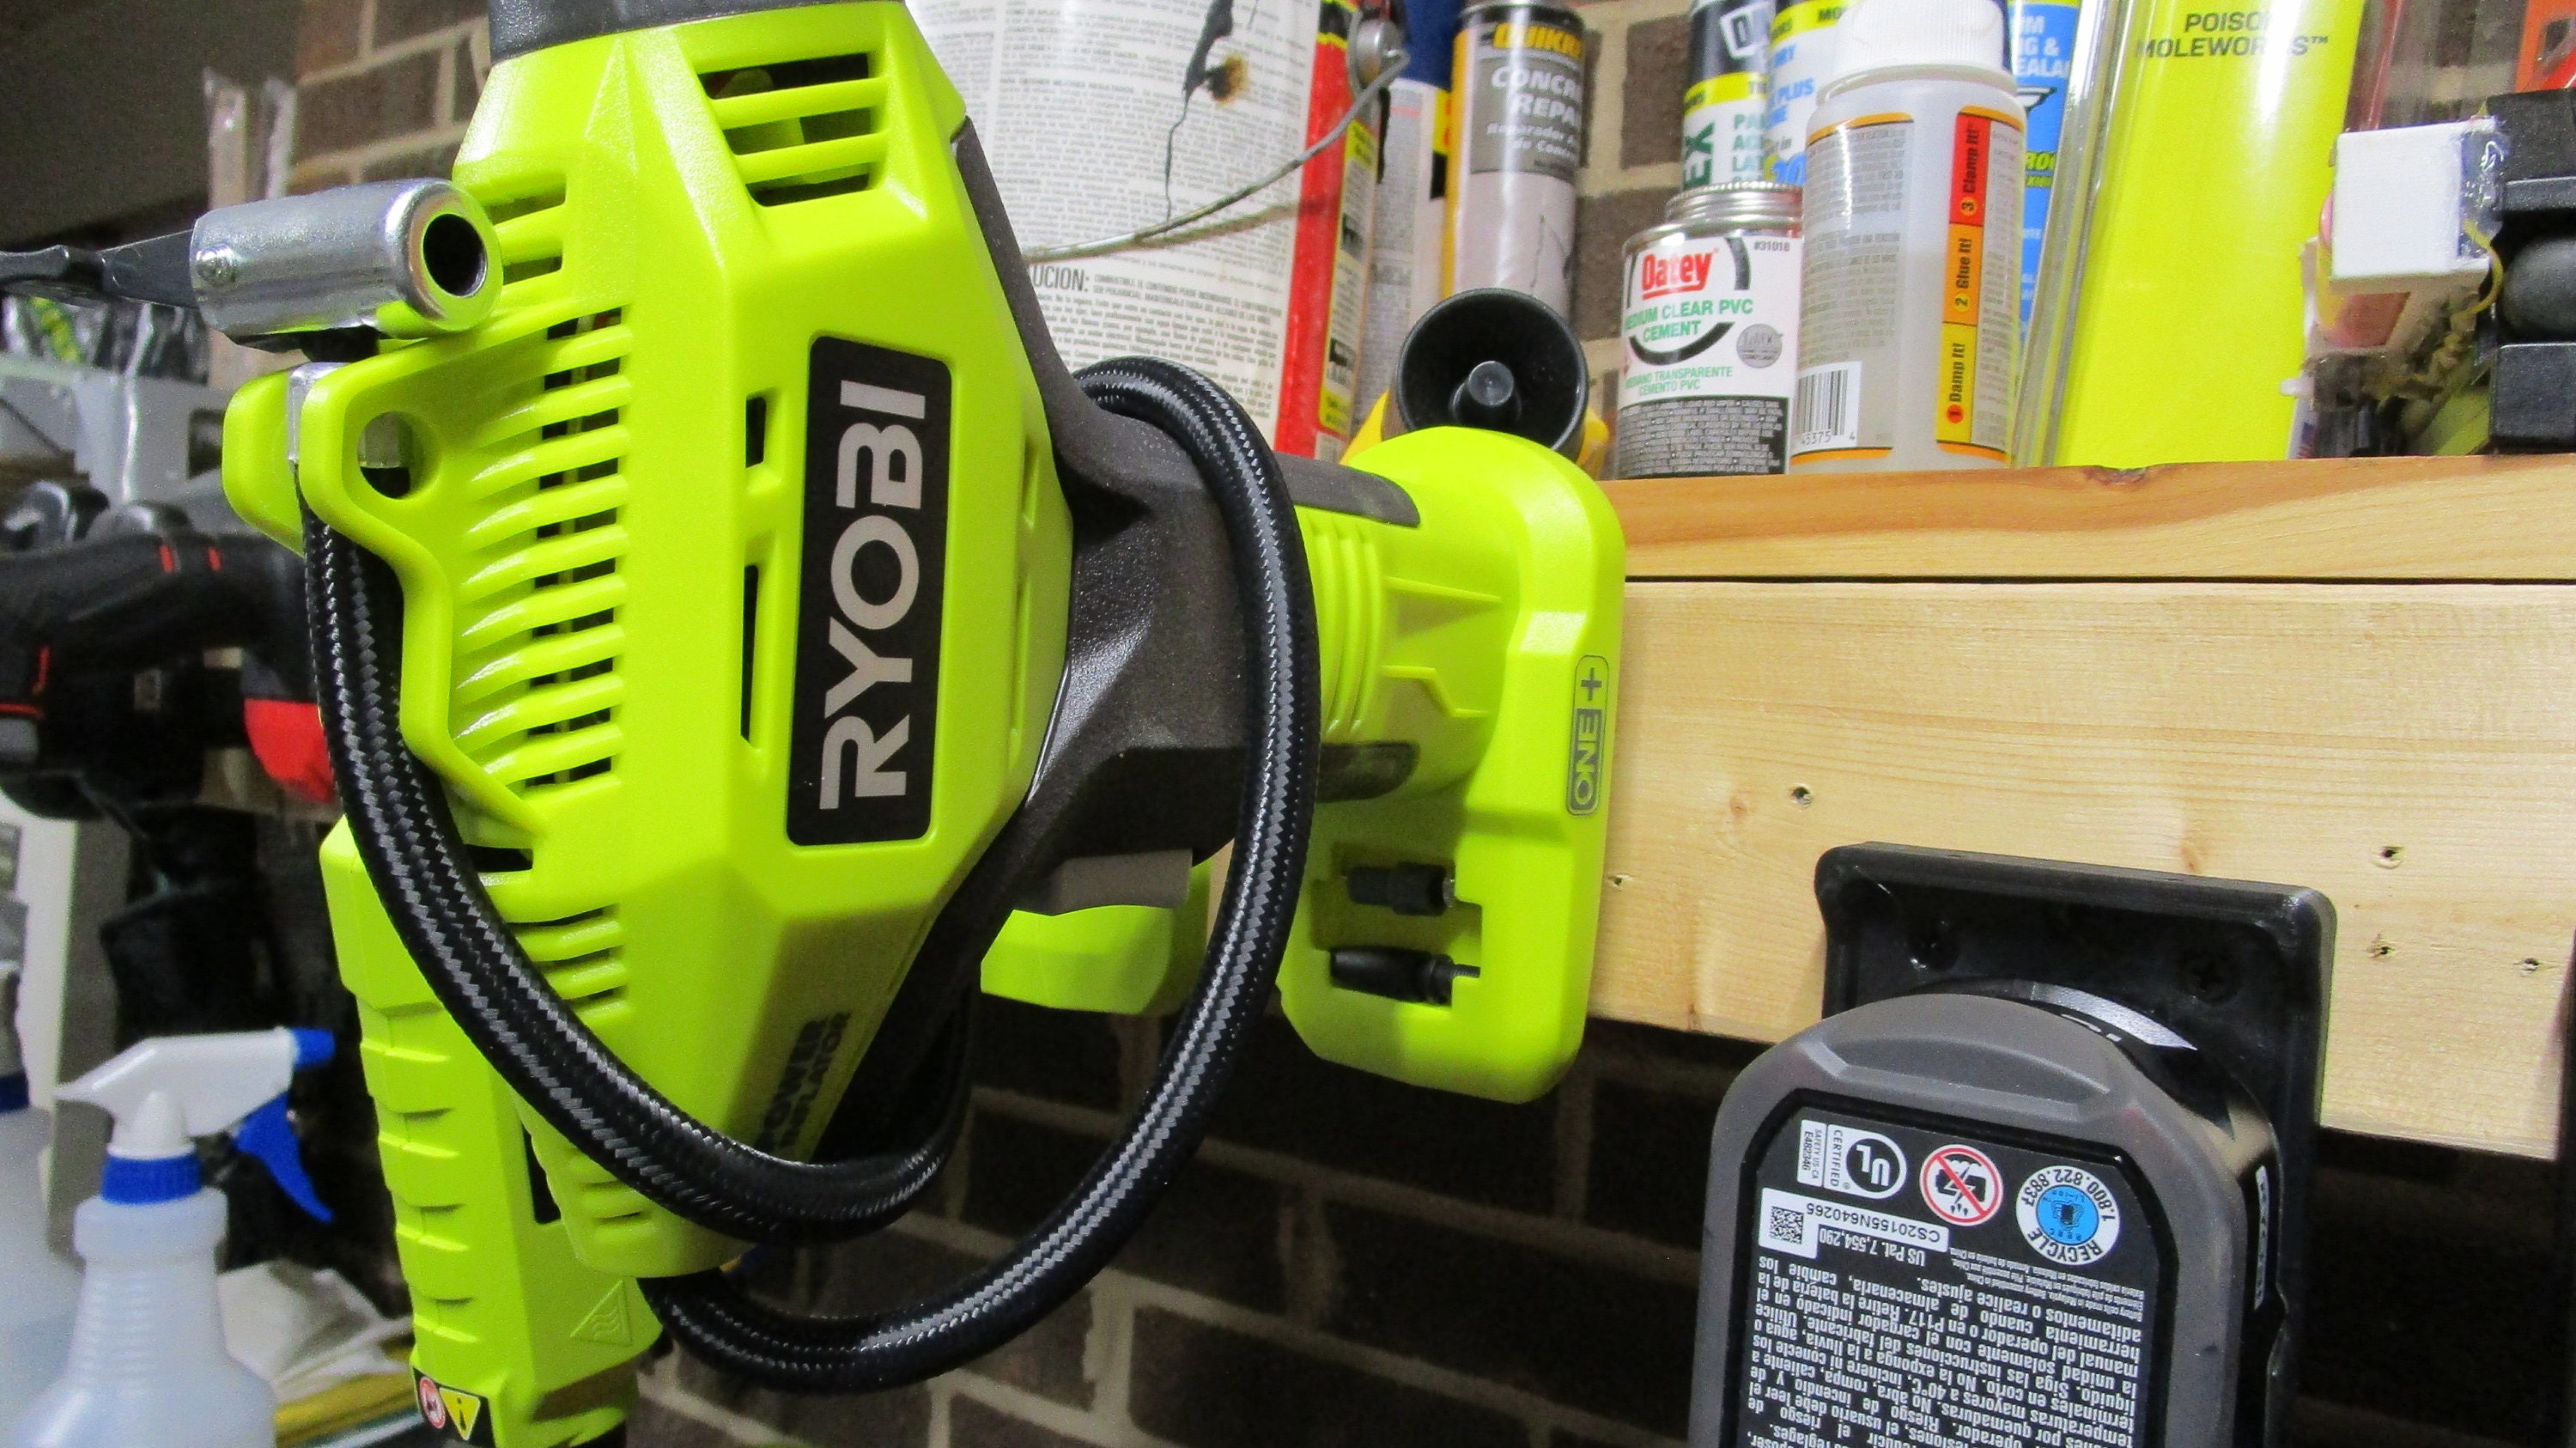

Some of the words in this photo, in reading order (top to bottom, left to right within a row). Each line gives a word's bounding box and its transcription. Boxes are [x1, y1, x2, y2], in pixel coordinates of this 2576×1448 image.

[1030, 265, 1090, 293] UCION:
[1642, 244, 1713, 298] Oatey
[1955, 257, 1972, 290] Glue
[1662, 301, 1713, 319] CLEAR
[1720, 299, 1753, 315] PVC
[1643, 320, 1701, 343] CEMENT
[1949, 362, 1966, 404] Damp
[818, 379, 927, 810] RYOBI
[1574, 703, 1598, 804] ONE
[1830, 1129, 1844, 1188] CERTIFIED
[1856, 1144, 1891, 1187] UL
[1819, 1227, 1878, 1256] 7,554,290
[1880, 1239, 1906, 1262] Pat.
[2026, 1227, 2103, 1262] RECYCLE
[1758, 1255, 1778, 1274] los
[1909, 1250, 1926, 1267] US
[1758, 1271, 1770, 1288] la
[1773, 1275, 1789, 1293] de
[1788, 1262, 1837, 1288] cambie
[1756, 1287, 1769, 1305] el
[1774, 1292, 1790, 1307] en
[1792, 1280, 1838, 1305] batería
[1841, 1292, 1855, 1310] la
[1847, 1274, 1940, 1314] almacenarla,
[1916, 1273, 1973, 1305] ajustes.
[1755, 1303, 1797, 1328] Utilice
[1795, 1297, 1852, 1325] indicado
[1857, 1296, 1899, 1321] Retire
[1949, 1301, 1968, 1321] de
[1976, 1291, 2028, 1317] realice
[2032, 1304, 2041, 1318] o
[1753, 1318, 1761, 1331] o
[1765, 1318, 1797, 1341] agua
[1801, 1315, 1874, 1348] fabricante.
[1857, 1310, 1920, 1343] cargador
[1904, 1307, 1944, 1332] P117.
[1947, 1318, 1965, 1335] en
[1969, 1323, 1978, 1338] o
[1979, 1309, 2033, 1337] cuando
[2044, 1307, 2141, 1345] aditamentos
[1752, 1334, 1771, 1353] los
[1801, 1328, 1843, 1356] lluvia,
[1847, 1342, 1859, 1360] la
[1879, 1335, 1901, 1354] del
[1925, 1329, 1940, 1348] el
[1945, 1335, 1971, 1353] con
[1981, 1323, 2048, 1359] operador
[2044, 1324, 2140, 1363] herramienta
[1752, 1349, 1759, 1363] a
[1775, 1340, 1826, 1368] conecte
[1830, 1354, 1843, 1372] ni
[1863, 1347, 1872, 1360] a
[1876, 1348, 1935, 1378] exponga
[1905, 1342, 2001, 1381] instrucciones
[1977, 1342, 2055, 1378] solamente
[2051, 1344, 2075, 1366] del
[2079, 1351, 2137, 1381] manual
[1750, 1365, 1766, 1384] de
[1763, 1353, 1815, 1381] caliente
[1776, 1369, 1784, 1385] y
[1820, 1365, 1868, 1393] rompa,
[1846, 1359, 1902, 1388] incinere
[1938, 1366, 1952, 1385] la
[2006, 1367, 2029, 1388] las
[2061, 1364, 2114, 1392] unidad
[1748, 1381, 1761, 1399] el
[1794, 1377, 1850, 1408] incendio
[1872, 1379, 1908, 1407] abra,
[1905, 1372, 1947, 1400] 40°C,
[1950, 1387, 1959, 1401] a
[1956, 1372, 1977, 1391] No
[1981, 1378, 2024, 1404] corto.
[2034, 1372, 2069, 1398] Siga
[2121, 1379, 2136, 1398] la
[1747, 1396, 1764, 1415] de
[1765, 1385, 1790, 1407] leer
[1794, 1394, 1826, 1418] debe
[1862, 1396, 1879, 1415] de
[1911, 1394, 1931, 1413] No
[1963, 1387, 2026, 1419] mayores
[2027, 1390, 2046, 1407] en
[2075, 1382, 2136, 1416] líquido.
[1779, 1402, 1821, 1432] riesgo
[1831, 1404, 1881, 1433] usuario
[1889, 1401, 1940, 1433] Riesgo
[1935, 1397, 2032, 1441] quemaduras.
[2029, 1405, 2133, 1448] temperaturas
[2050, 1396, 2134, 1433] terminales
[1837, 1422, 1850, 1440] el
[1885, 1420, 1899, 1439] el
[2035, 1424, 2061, 1446] por
